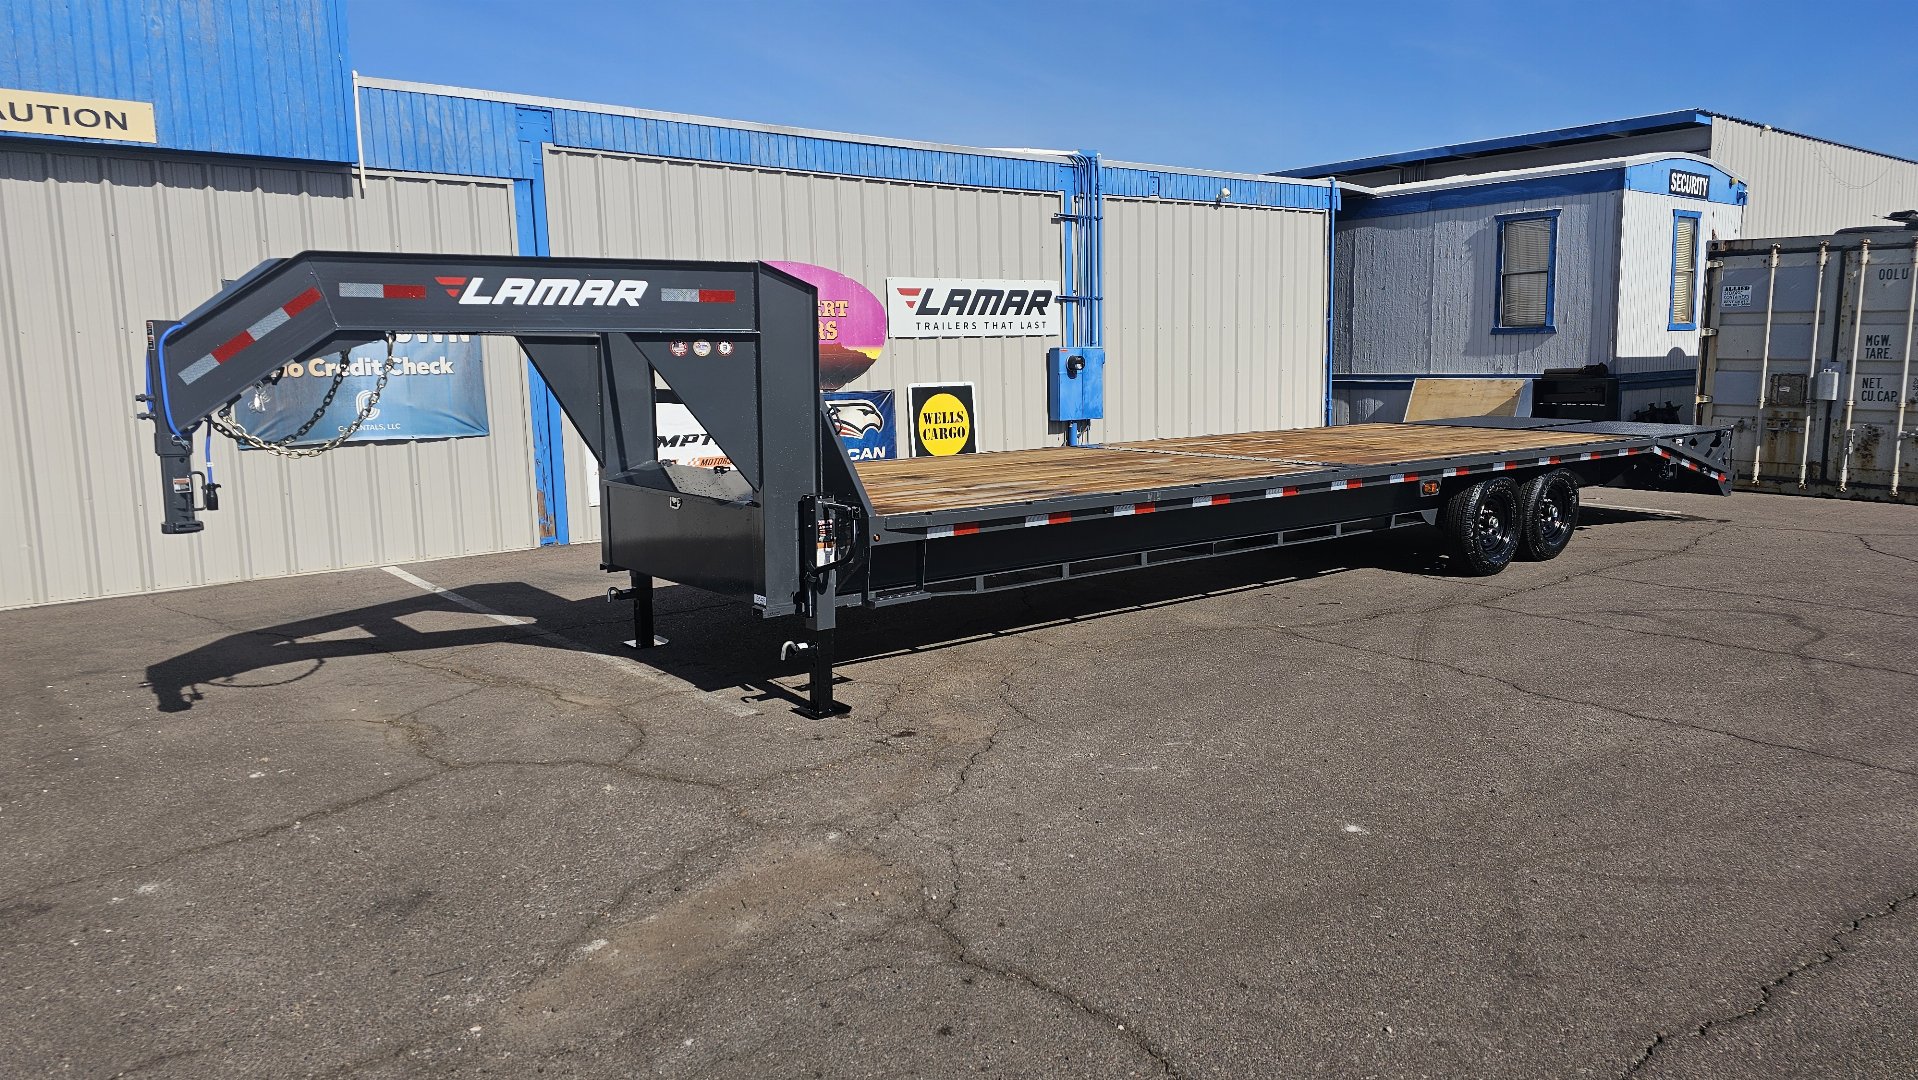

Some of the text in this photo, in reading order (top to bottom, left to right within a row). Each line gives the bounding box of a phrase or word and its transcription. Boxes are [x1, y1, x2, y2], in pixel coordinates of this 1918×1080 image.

[1671, 172, 1708, 197] SECURITY
[458, 277, 649, 307] LAMAR
[915, 288, 1053, 316] LAMAR
[915, 320, 1048, 331] TRAILERS THAT LAST
[1865, 334, 1892, 347] MGW.
[1865, 347, 1893, 360] TARE.
[308, 357, 383, 378] Credit
[389, 356, 455, 376] Check
[1861, 377, 1884, 389] NET.
[923, 410, 964, 425] WELLS
[922, 426, 966, 441] CARGO
[847, 446, 886, 461] CAN
